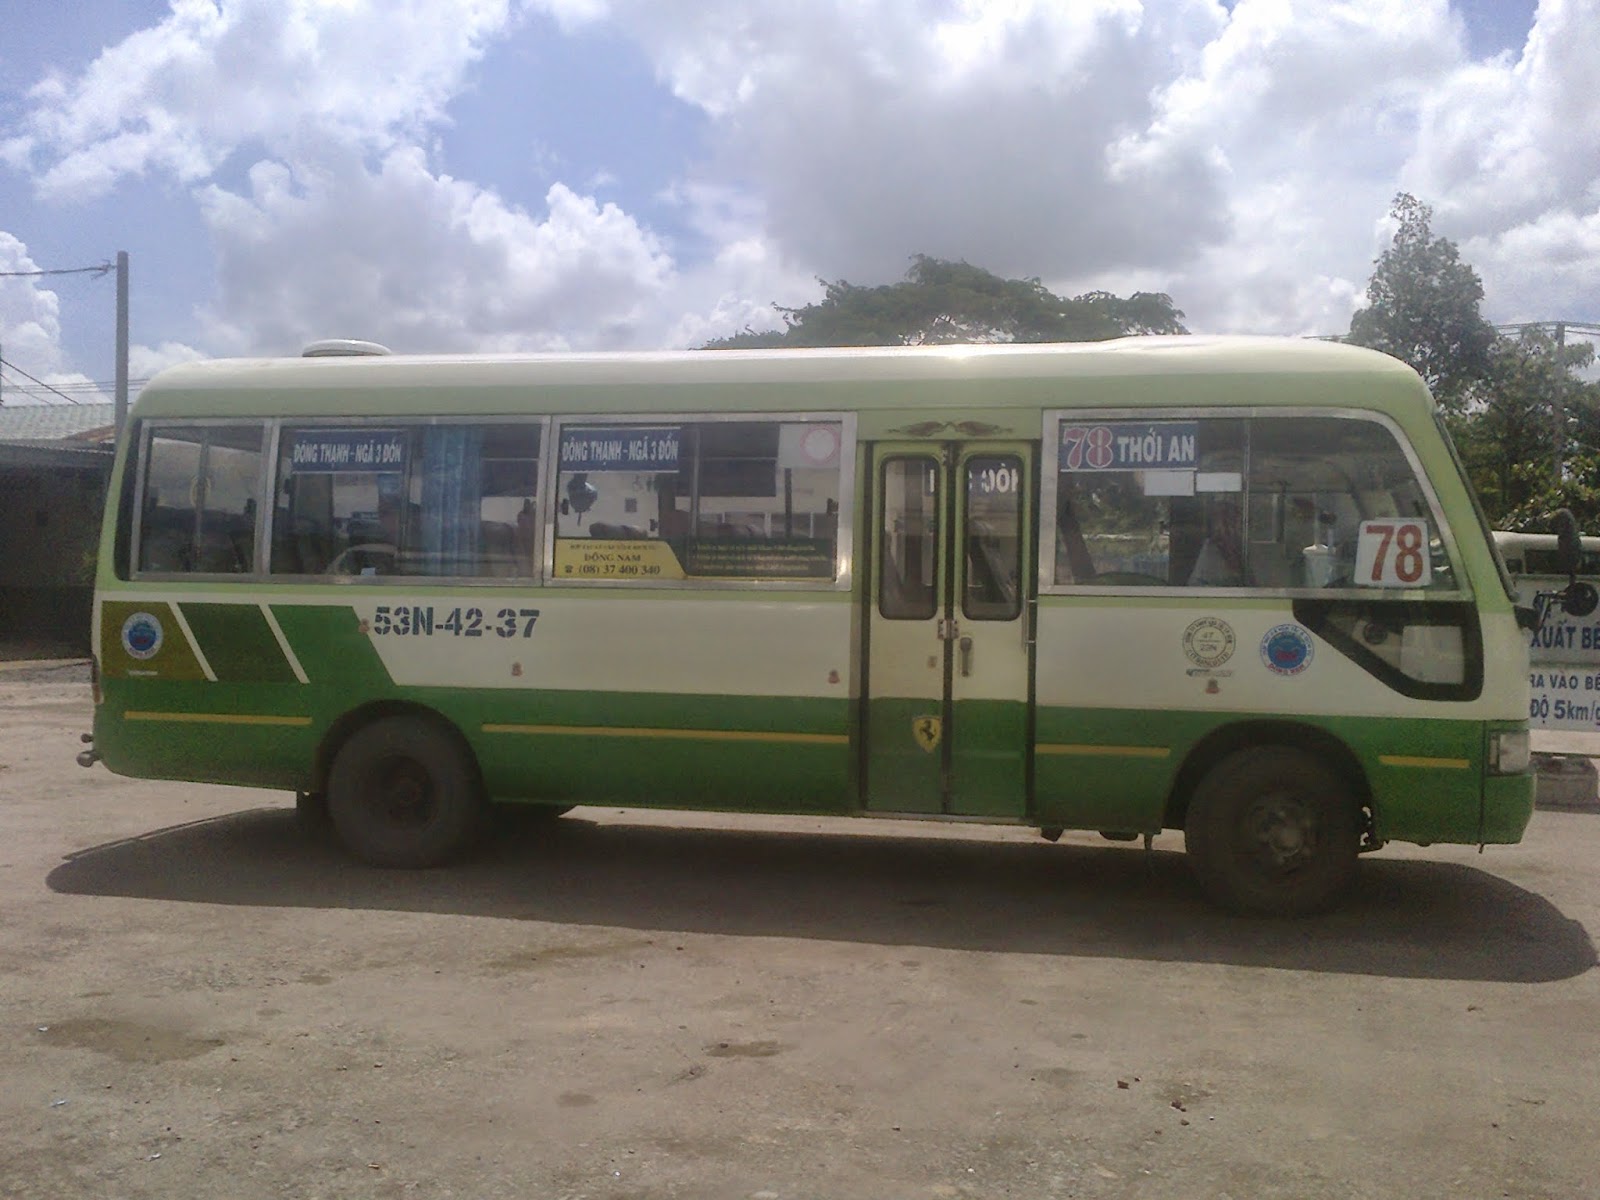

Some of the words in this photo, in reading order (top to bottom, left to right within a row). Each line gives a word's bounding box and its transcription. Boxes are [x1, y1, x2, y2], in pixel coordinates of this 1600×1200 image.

[375, 443, 382, 463] 3
[651, 440, 658, 461] 3
[1063, 426, 1113, 469] 78
[1167, 435, 1195, 462] AN
[1366, 524, 1424, 583] 78
[373, 606, 541, 639] 53N-42-37
